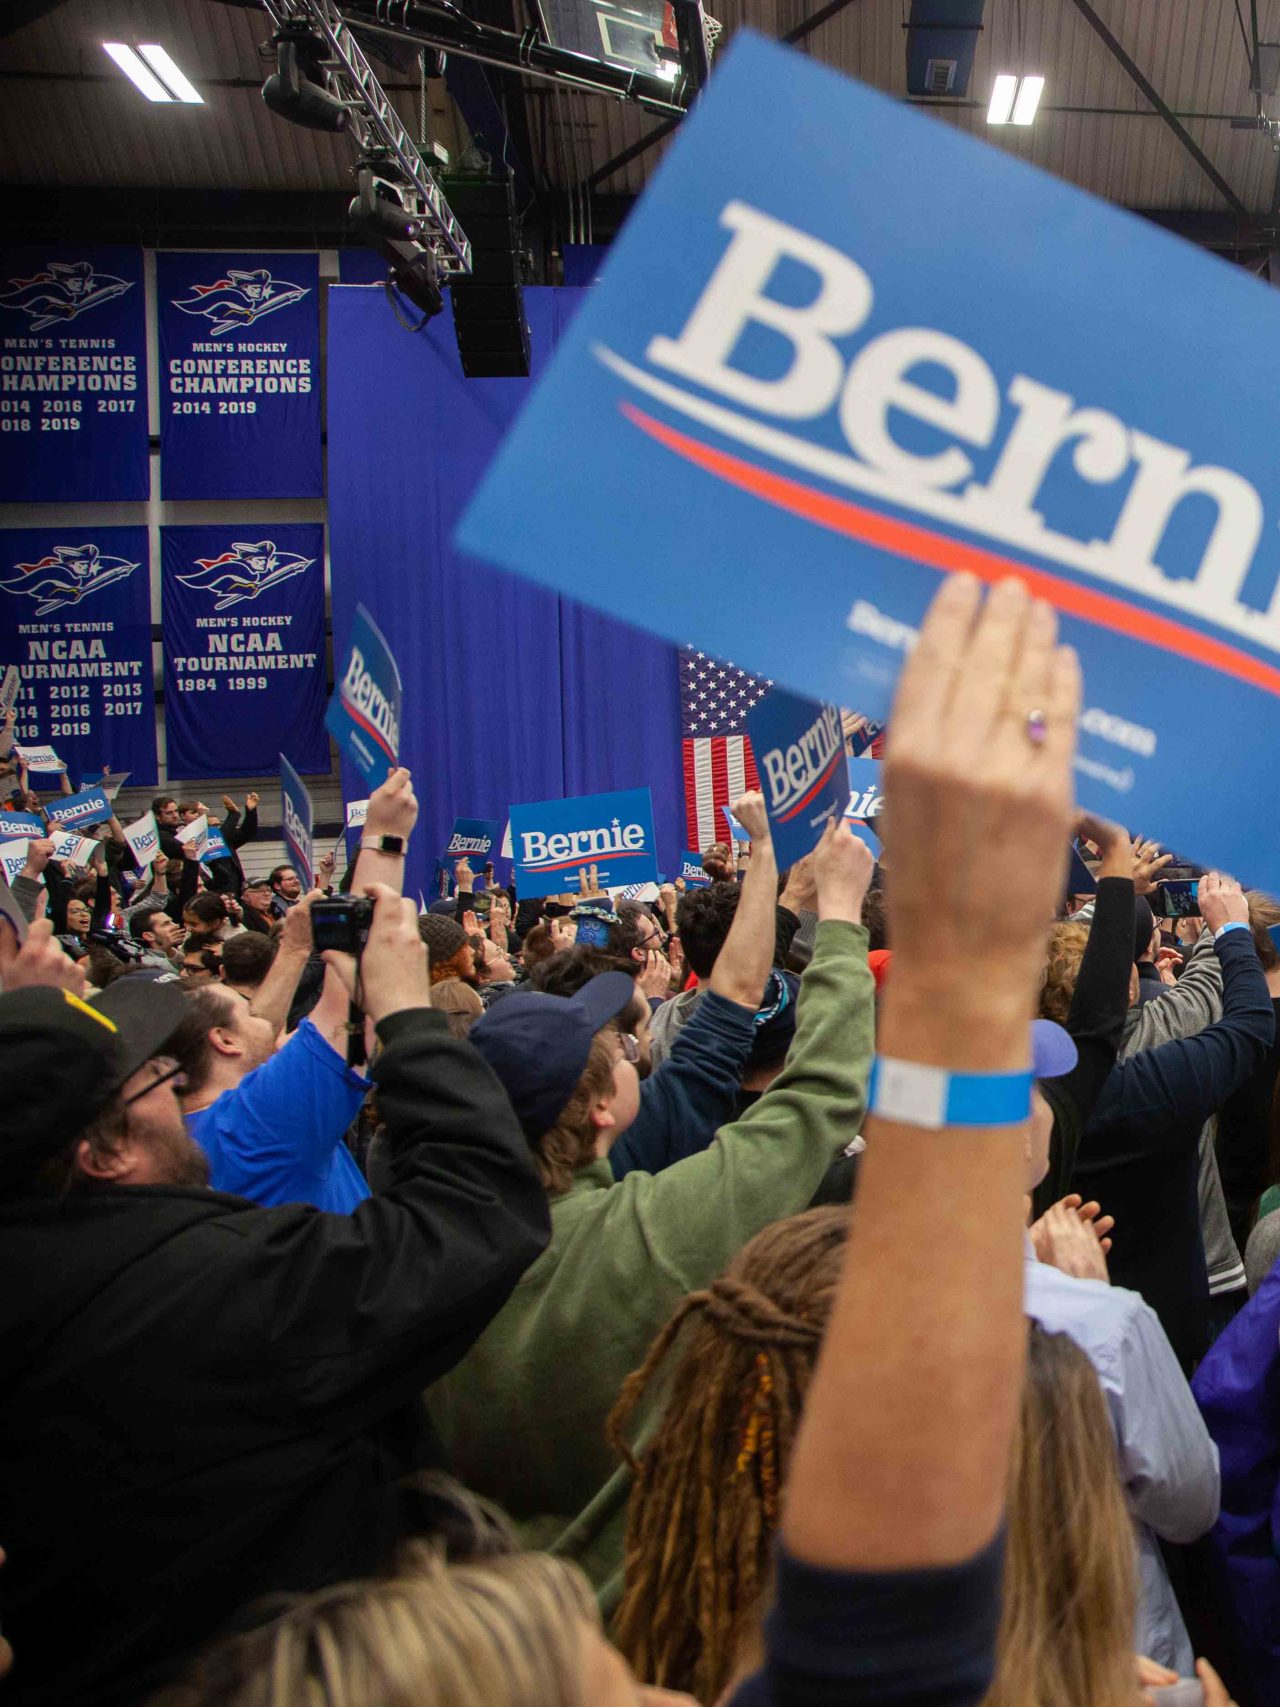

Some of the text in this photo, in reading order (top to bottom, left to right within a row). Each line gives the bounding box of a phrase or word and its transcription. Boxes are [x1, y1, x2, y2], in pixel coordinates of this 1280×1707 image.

[4, 338, 115, 348] MEN'S TENNIS
[192, 343, 287, 352] MEN'S HOCKEY
[170, 359, 311, 374] CONFERENCE
[170, 377, 311, 393] CHAMPIONS
[43, 400, 82, 412] 2016
[98, 400, 136, 412] 2017
[173, 402, 256, 414] 2014 2019
[41, 418, 80, 431] 2019
[18, 622, 114, 634] MEN'S TENNIS
[196, 616, 293, 628] MEN'S HOCKEY
[29, 639, 107, 660] NCAA
[208, 632, 283, 653] NCAA
[0, 661, 142, 680] TURNAMENT
[174, 654, 317, 672] TOURNAMENT
[50, 685, 90, 699] 2012
[103, 683, 142, 697] 2013
[177, 677, 267, 691] 1984 1999
[50, 704, 91, 718] 2016
[105, 702, 142, 716] 2017
[51, 722, 91, 736] 2019
[763, 700, 840, 807] Bernie
[52, 799, 105, 820] Bernie
[0, 821, 44, 837] Bernie
[449, 833, 492, 853] Bernie
[521, 817, 645, 863] Bernie
